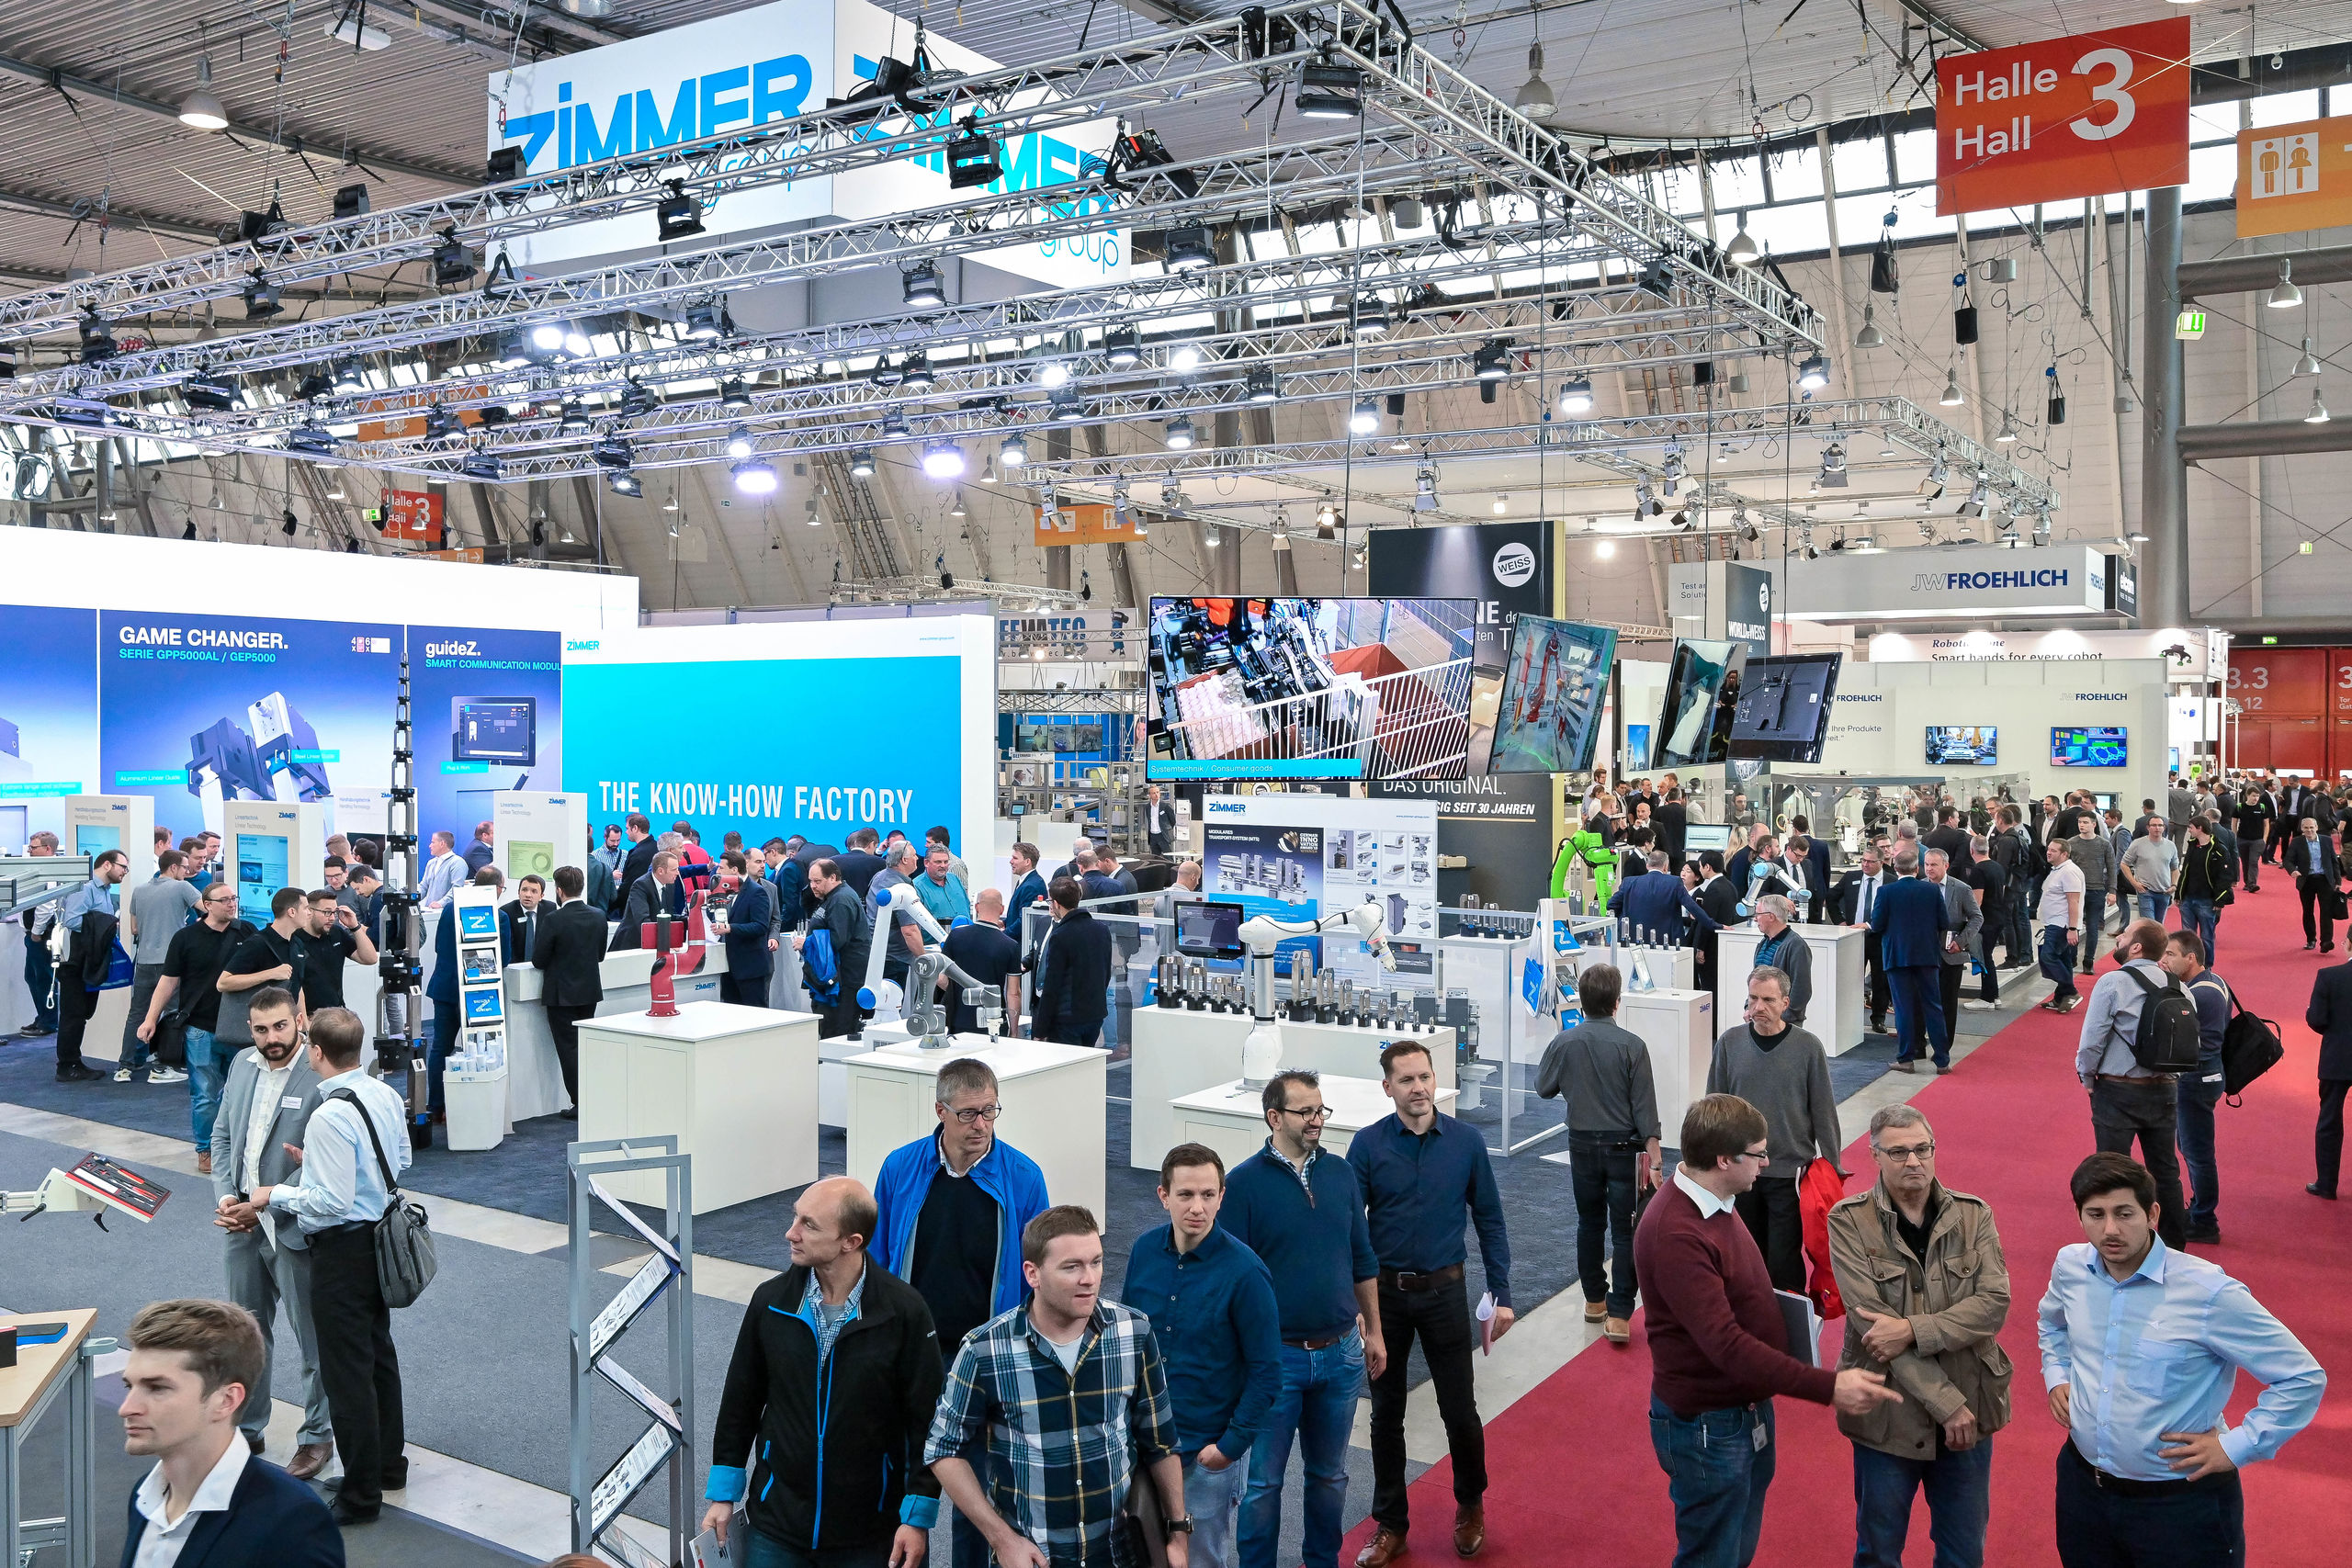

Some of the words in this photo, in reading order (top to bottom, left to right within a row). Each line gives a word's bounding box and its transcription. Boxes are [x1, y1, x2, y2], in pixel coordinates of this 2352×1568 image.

[1955, 61, 2058, 106] Halle
[2069, 48, 2136, 141] 3
[1955, 116, 2030, 160] Hall
[1497, 556, 1532, 574] WEISS
[1476, 601, 1499, 624] NE
[119, 626, 182, 646] GAME
[187, 628, 288, 649] CHANGER.
[1476, 630, 1494, 641] ten
[119, 649, 153, 660] SERIE
[157, 649, 220, 661] GPP5000AL
[230, 652, 276, 663] GEP5000
[425, 640, 481, 659] guideZ.
[1931, 653, 1964, 661] Smart
[1970, 653, 2005, 661] hands
[2009, 652, 2027, 661] for
[2068, 651, 2103, 661] cobot
[425, 659, 457, 669] SMART
[458, 660, 530, 670] COMMUNICATION
[2245, 696, 2263, 710] 12
[1150, 764, 1204, 773] Systemtechnik
[1211, 764, 1249, 773] Consumer
[1250, 764, 1273, 773] goods
[599, 781, 639, 813] THE
[650, 782, 783, 818] KNOW-HOW
[795, 785, 913, 824] FACTORY
[1453, 802, 1476, 814] SEIT
[1477, 803, 1490, 815] 30
[1490, 803, 1535, 816] JAHREN
